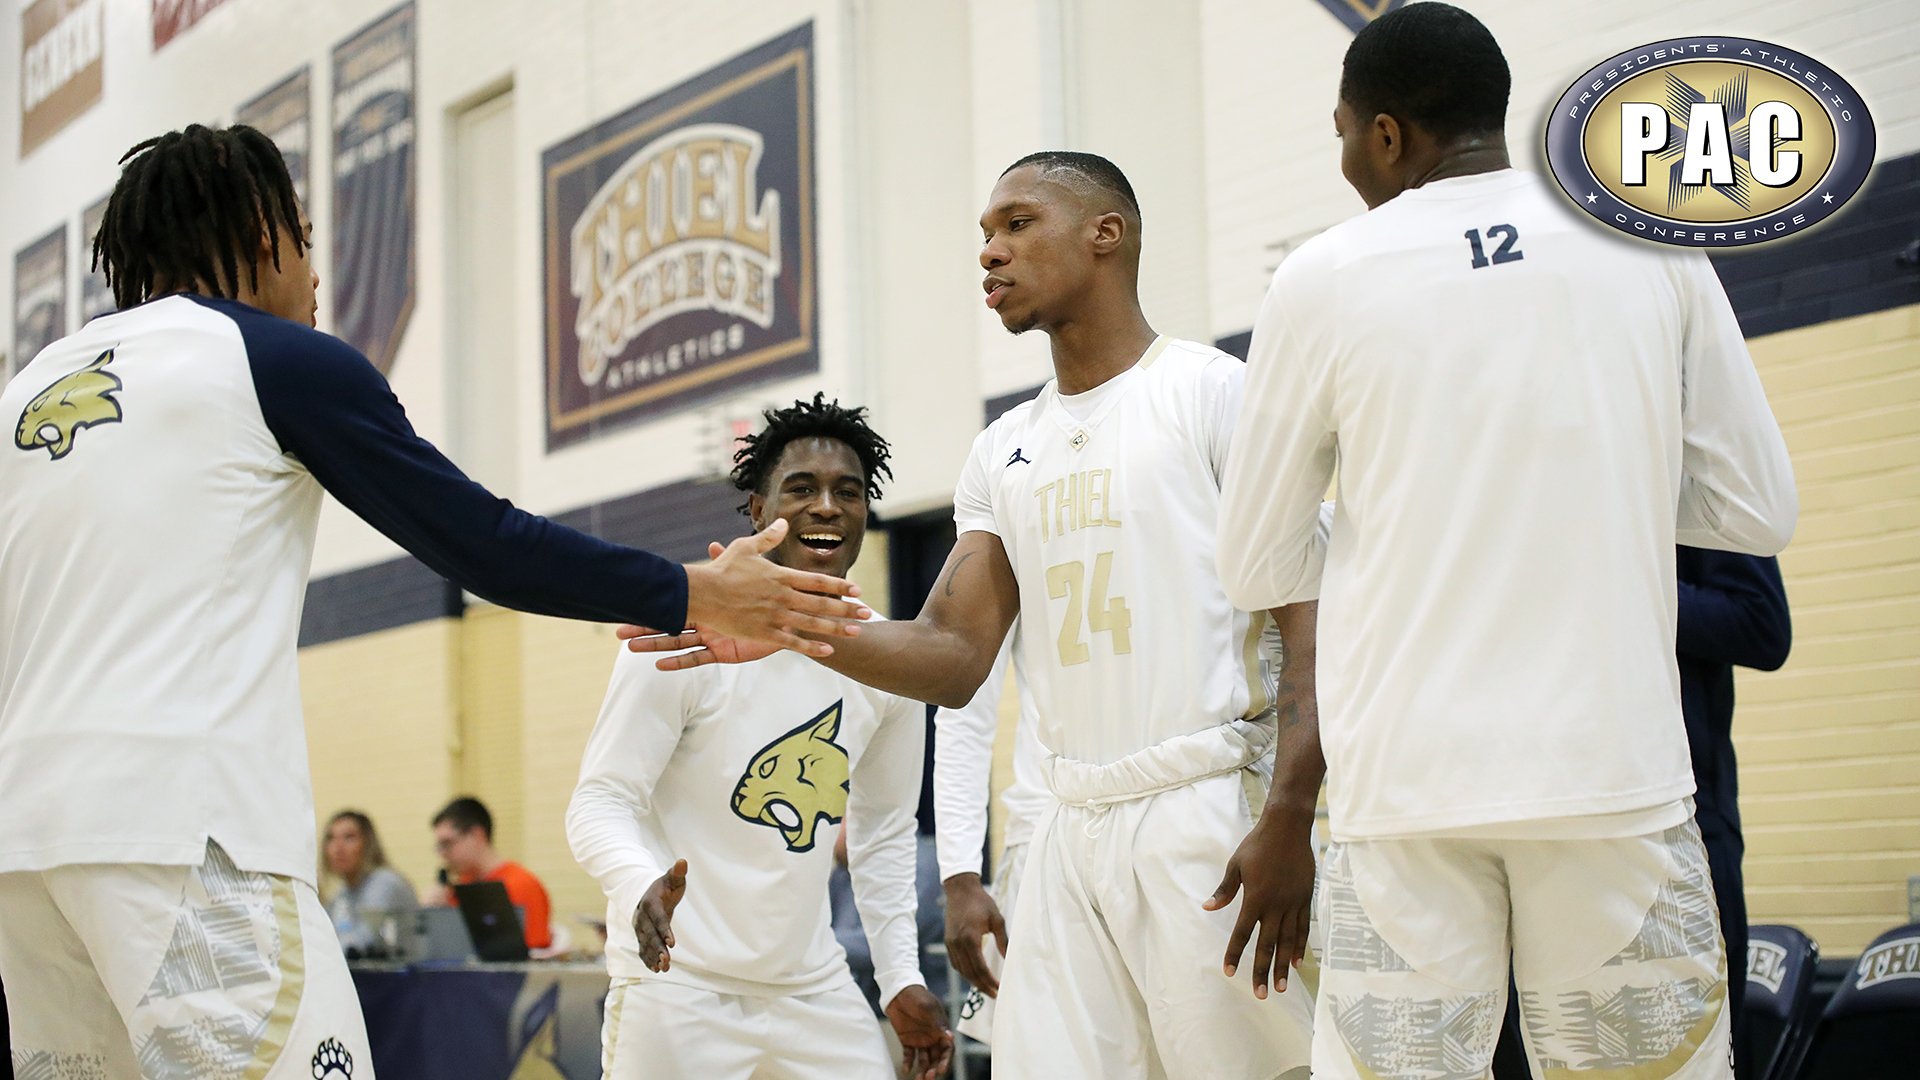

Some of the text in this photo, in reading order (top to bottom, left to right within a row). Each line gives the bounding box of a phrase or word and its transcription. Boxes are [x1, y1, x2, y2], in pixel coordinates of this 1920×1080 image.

[571, 123, 781, 298] THIEL
[1464, 223, 1524, 269] 12
[577, 238, 776, 386] COLLEGE
[606, 324, 745, 388] ATHLETICS
[1034, 468, 1122, 543] THIEL
[1045, 551, 1131, 667] 24
